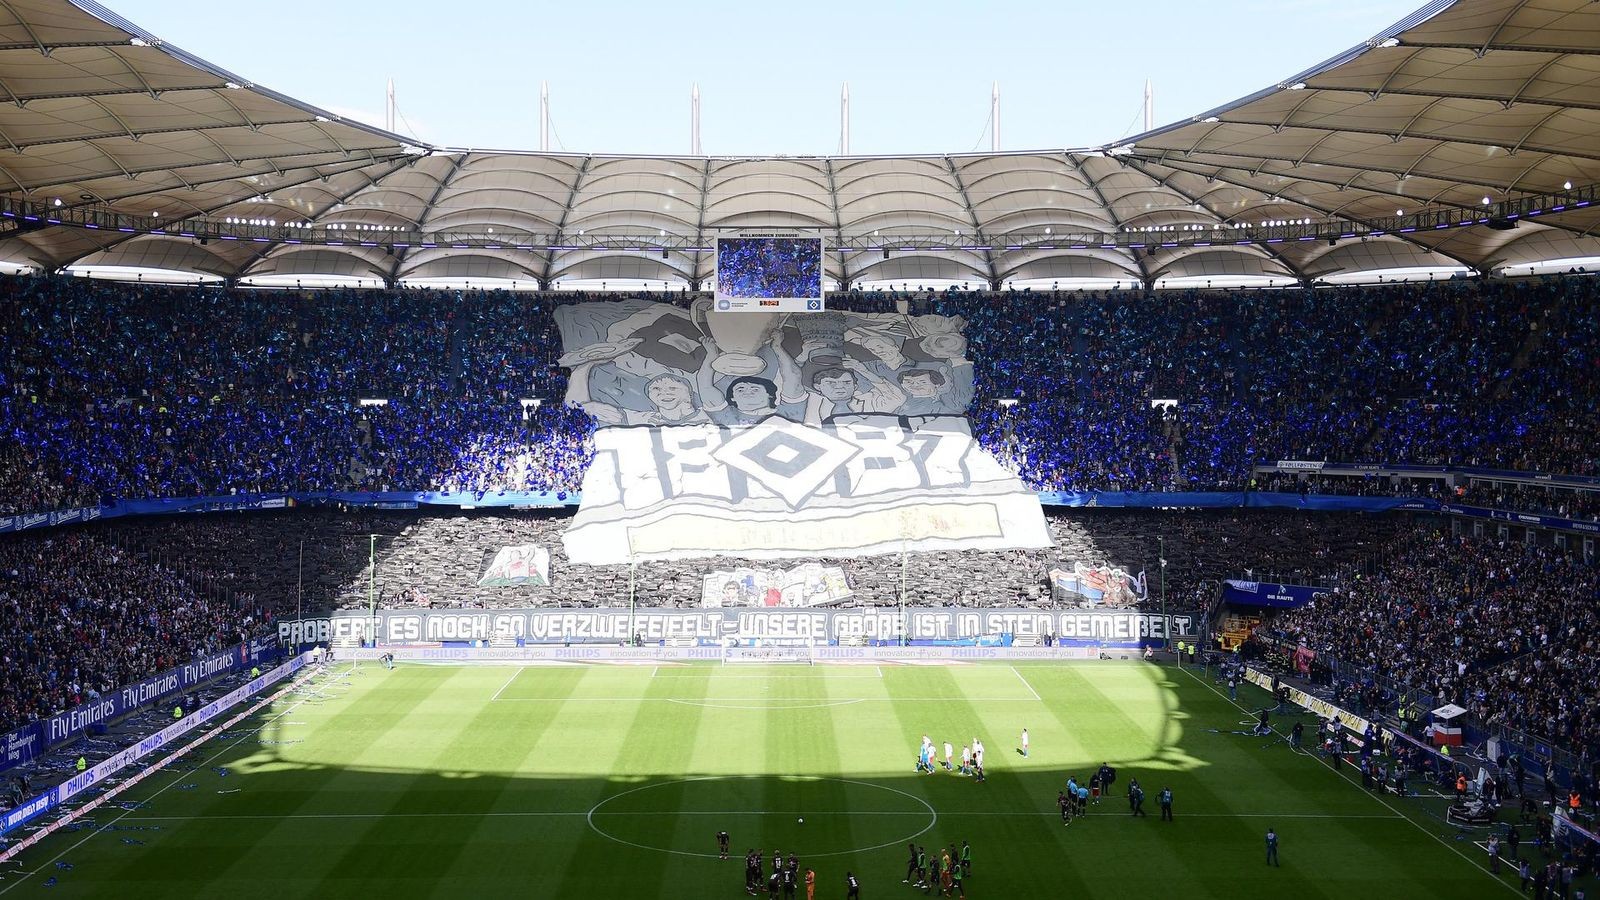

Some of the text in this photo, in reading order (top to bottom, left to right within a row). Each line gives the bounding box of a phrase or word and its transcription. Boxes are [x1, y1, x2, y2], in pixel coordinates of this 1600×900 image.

[388, 616, 421, 641] ES
[427, 615, 488, 639] NOCH
[738, 613, 826, 637] UNSERE
[914, 613, 950, 637] IST
[957, 613, 980, 637] IN
[184, 652, 234, 684] Fly Emirates
[423, 649, 468, 658] PHILIPS
[122, 672, 178, 709] Fly Emirates
[51, 699, 115, 740] Fly Emirates
[67, 769, 95, 796] PHILIPS
